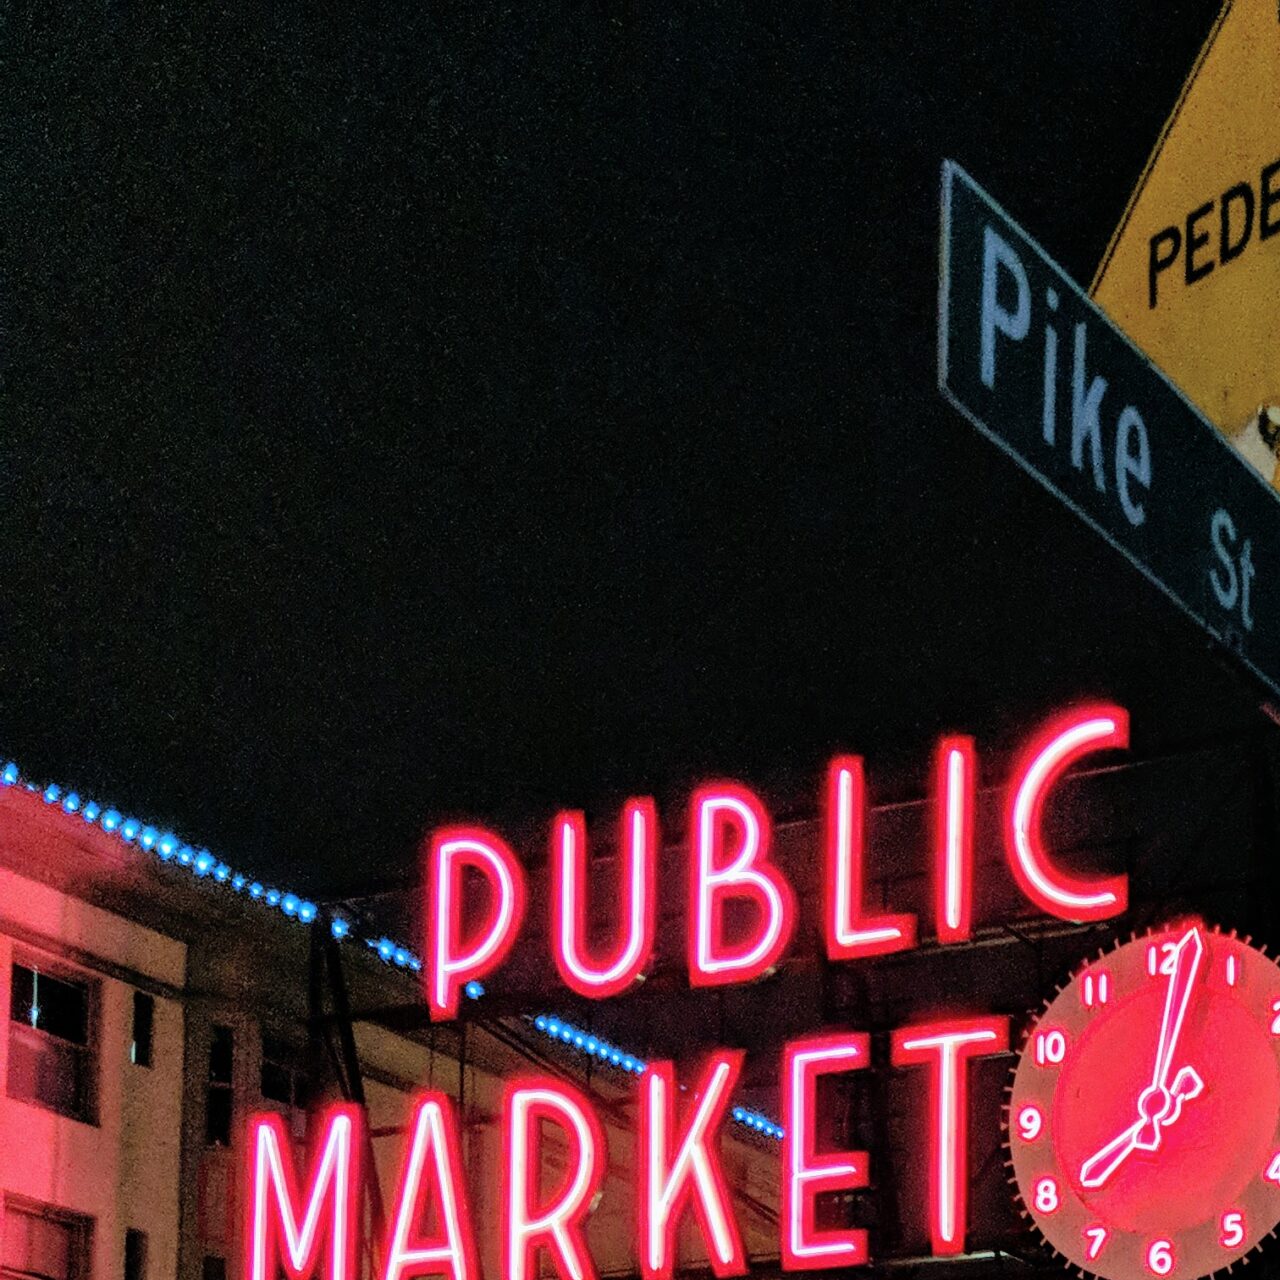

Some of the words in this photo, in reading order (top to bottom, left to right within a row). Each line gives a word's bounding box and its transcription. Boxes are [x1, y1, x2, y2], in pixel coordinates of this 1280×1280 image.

[981, 225, 1151, 526] Pike
[1211, 508, 1255, 630] St
[428, 700, 1130, 1021] PUBLIC
[1226, 954, 1236, 986] 1
[1084, 974, 1108, 1006] 11
[1036, 1031, 1066, 1064] 10
[1018, 1107, 1042, 1140] 9
[1035, 1179, 1058, 1213] 8
[1086, 1227, 1107, 1259] 7
[1222, 1212, 1244, 1247] 5
[1147, 1240, 1172, 1275] 6
